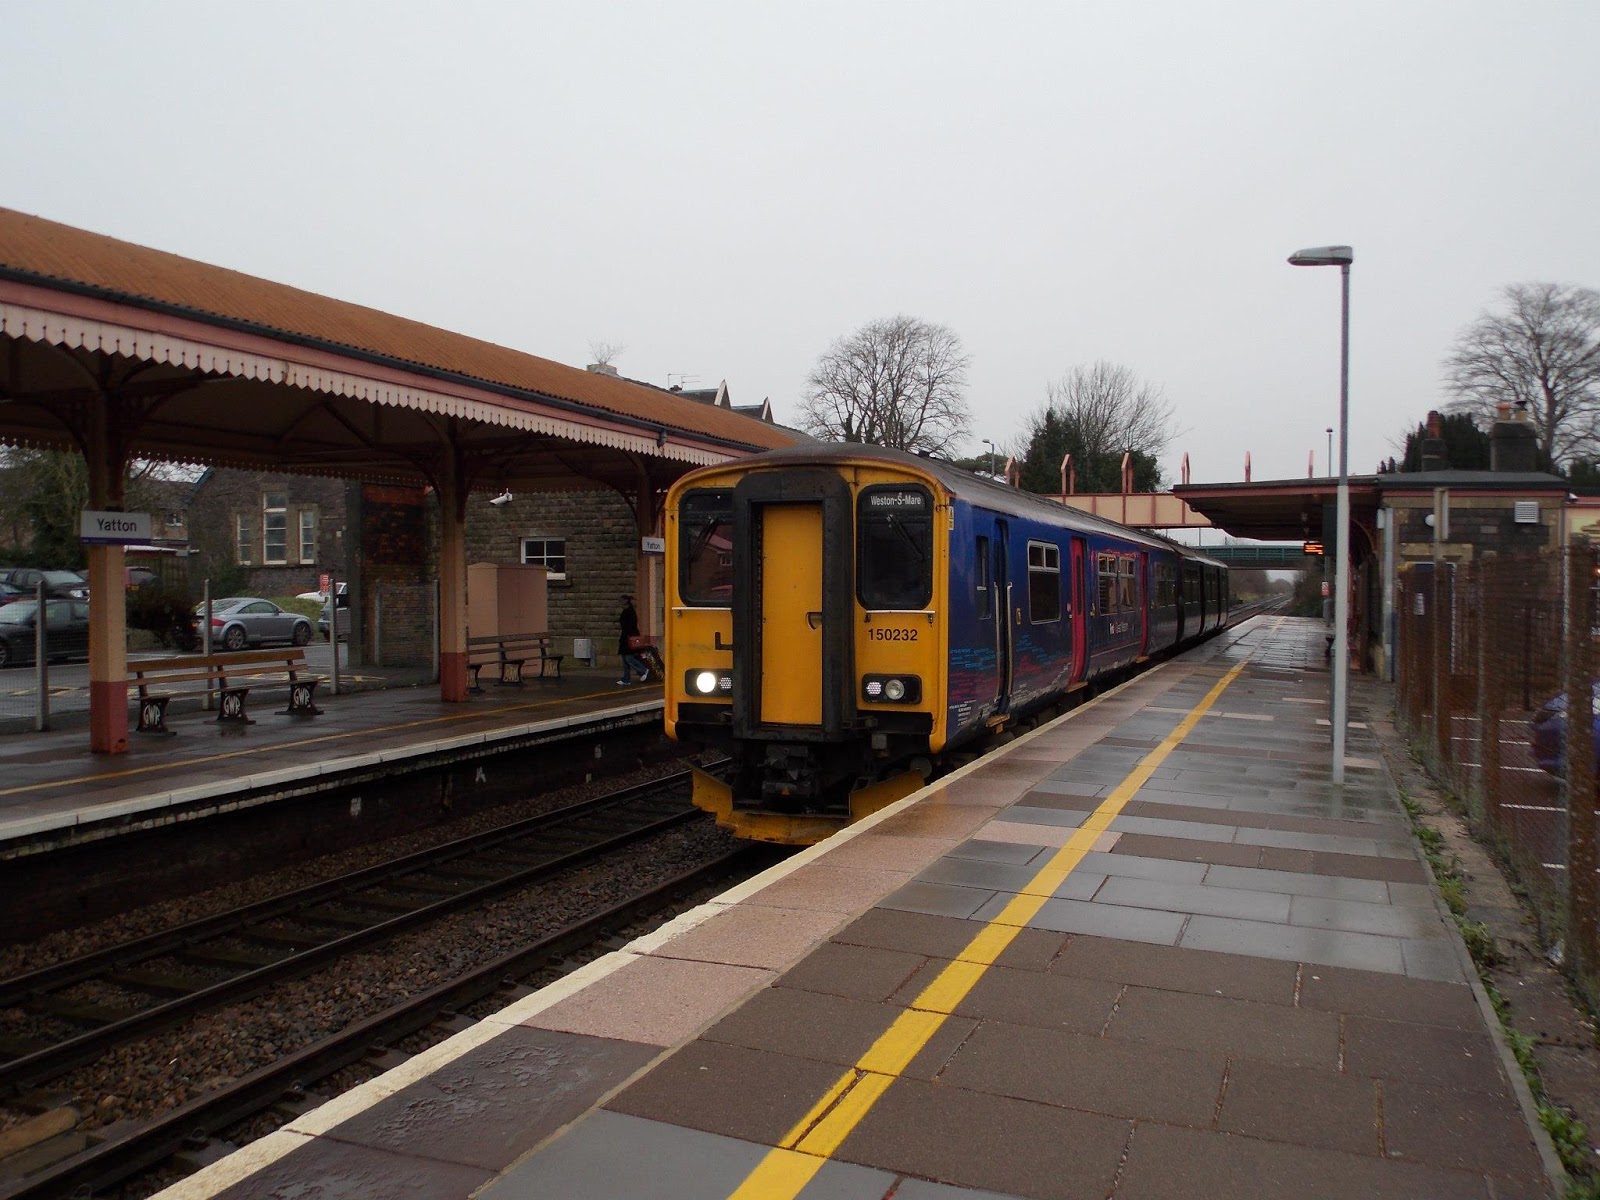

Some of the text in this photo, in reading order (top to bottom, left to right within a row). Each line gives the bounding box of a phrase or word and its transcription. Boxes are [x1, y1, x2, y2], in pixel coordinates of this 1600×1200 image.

[870, 495, 921, 506] Weston-S-Mare
[97, 518, 137, 532] Yatton
[868, 628, 918, 641] 150232
[293, 687, 310, 706] GWR
[223, 695, 241, 715] GWR
[143, 704, 161, 726] GWR
